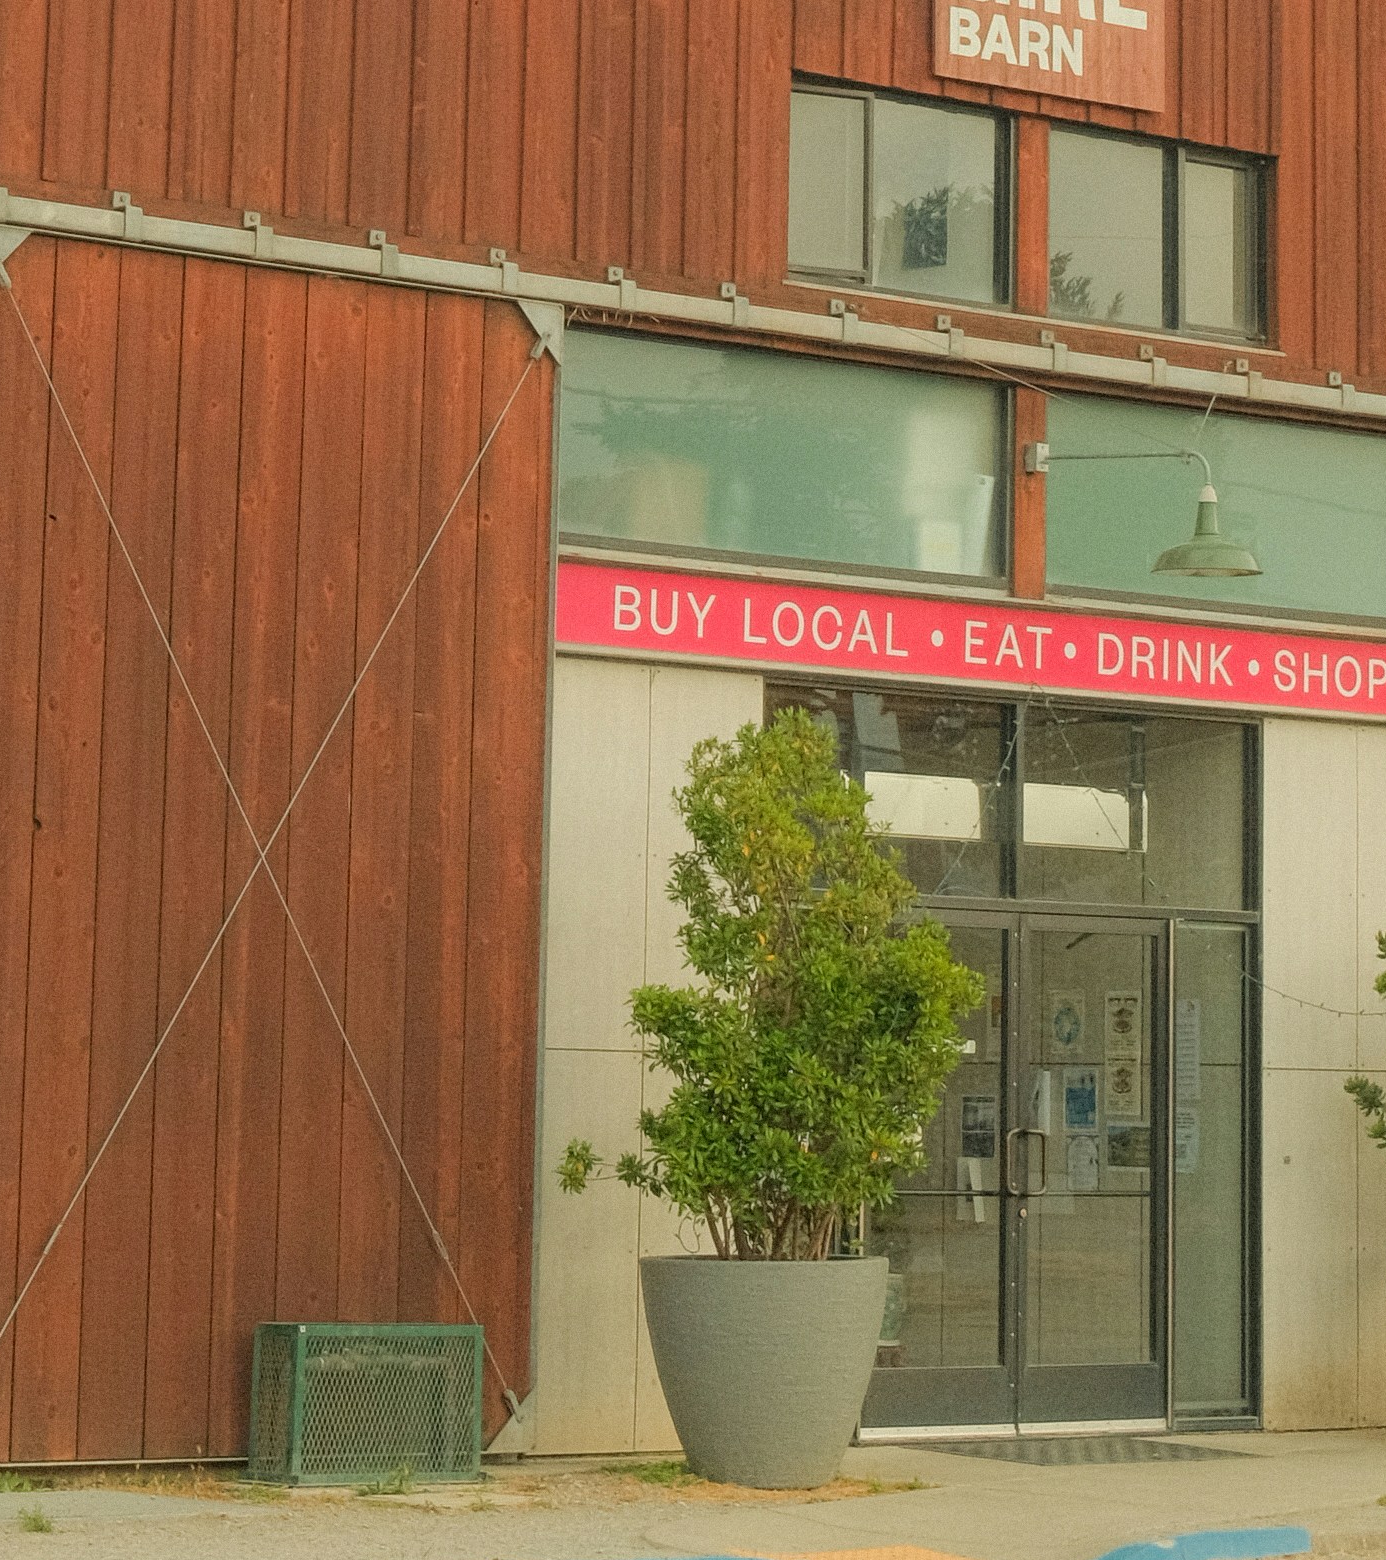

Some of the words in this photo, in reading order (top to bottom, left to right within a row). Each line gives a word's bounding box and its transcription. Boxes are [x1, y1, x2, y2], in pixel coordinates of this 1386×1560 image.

[949, 6, 1083, 76] BARN
[614, 584, 716, 639] BUY
[743, 598, 908, 657] LOCAL
[964, 620, 1053, 670] EAT
[1098, 632, 1234, 687] DRINK
